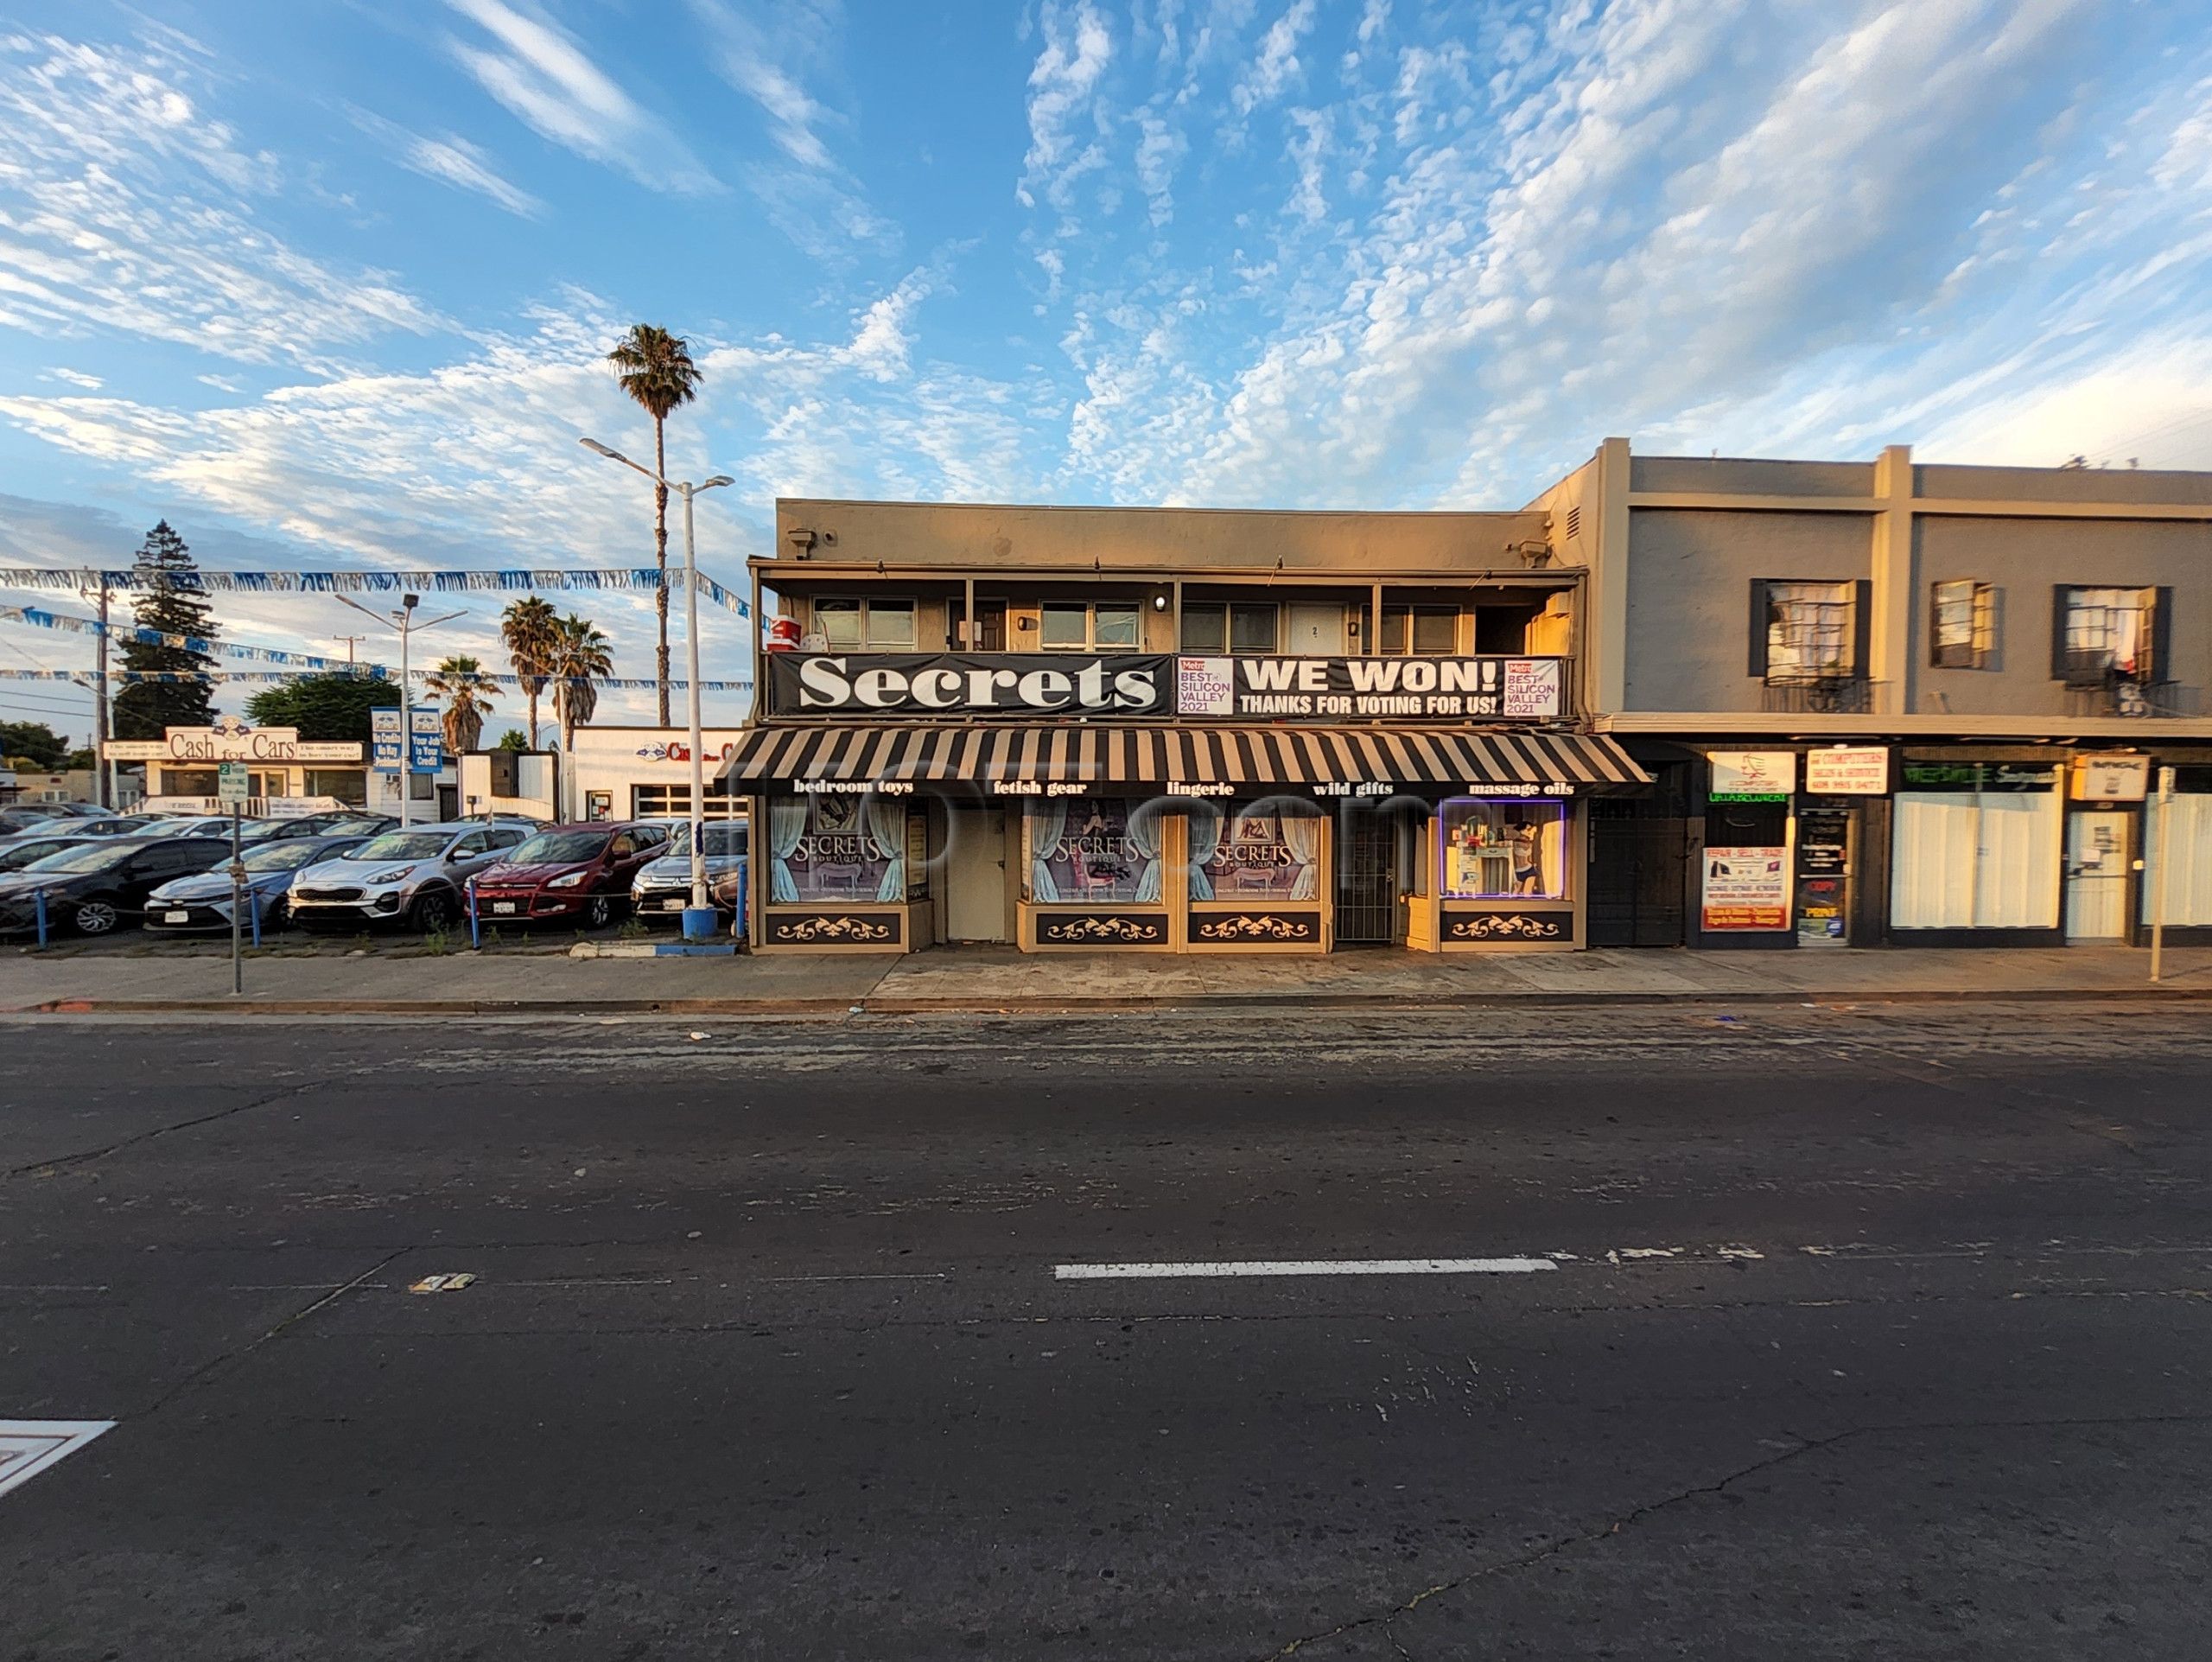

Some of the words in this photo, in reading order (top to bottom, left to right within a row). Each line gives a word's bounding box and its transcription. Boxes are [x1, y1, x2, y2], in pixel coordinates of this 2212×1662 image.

[799, 657, 1155, 707] Secrets
[1181, 672, 1212, 682] BEST
[1242, 660, 1328, 691] WE
[1346, 661, 1496, 692] WON!
[1509, 675, 1539, 684] BEST
[1180, 683, 1230, 691] SILICON
[1180, 692, 1226, 702] VALLEY
[1240, 695, 1312, 714] THANKS
[1317, 696, 1351, 714] FOR
[1357, 697, 1421, 714] VOTING
[1427, 696, 1461, 714] FOR
[1466, 697, 1497, 713] US!
[1508, 695, 1550, 704] VALLEY
[1180, 702, 1209, 711] 2021
[1507, 704, 1534, 713] 2021
[170, 734, 214, 759] Cash
[222, 749, 246, 760] for
[252, 734, 295, 759] Cars
[221, 765, 228, 774] 2
[794, 780, 873, 793] bedroom
[878, 781, 914, 796] toys
[994, 780, 1041, 794] fetish
[1047, 784, 1087, 797] gear
[1167, 781, 1235, 798] lingerie
[1313, 782, 1351, 795] wild
[1356, 782, 1394, 797] gifts
[1469, 784, 1540, 797] massage
[1543, 782, 1574, 795] oils
[795, 836, 880, 862] SECRETS
[1055, 837, 1140, 863] SECRETS
[1213, 845, 1292, 868] SECRETS
